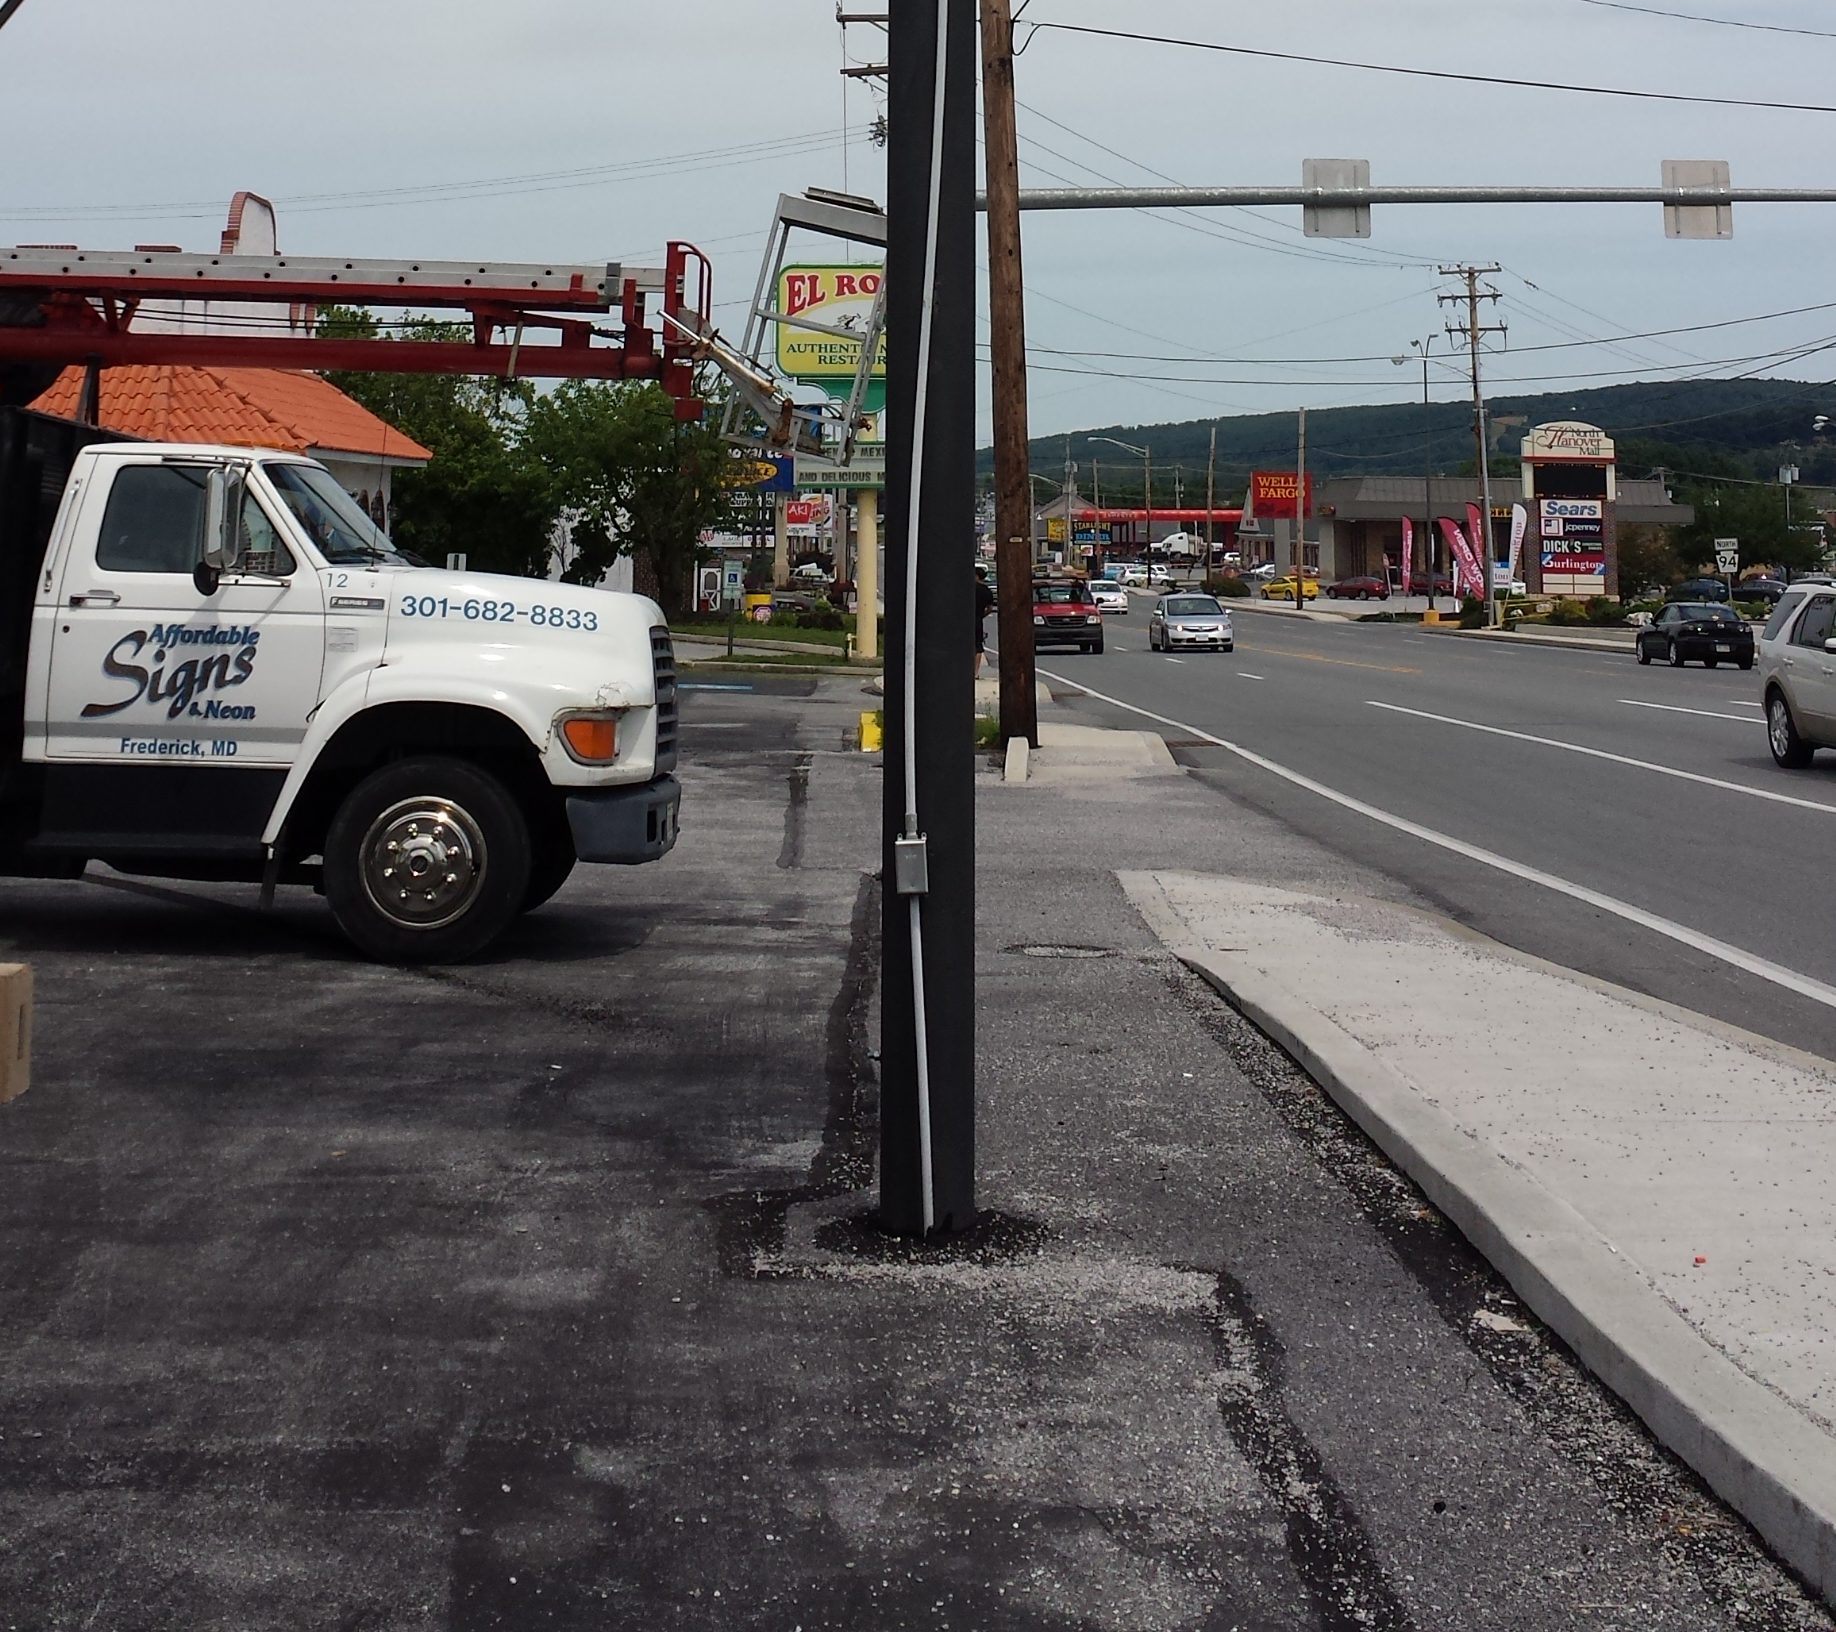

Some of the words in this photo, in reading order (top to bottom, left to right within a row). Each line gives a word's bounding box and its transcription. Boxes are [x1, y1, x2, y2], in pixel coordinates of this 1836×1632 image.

[786, 274, 826, 316] EL
[835, 274, 881, 297] RO
[786, 343, 864, 354] AUTHENT
[817, 354, 887, 365] RESTR
[1537, 425, 1602, 449] Hanover
[1570, 427, 1600, 438] North
[860, 447, 885, 457] MEXI
[1579, 446, 1600, 456] Mall
[798, 471, 817, 482] AND
[821, 471, 871, 482] DELICIOUS
[1545, 501, 1597, 516] Sears
[1073, 522, 1111, 531] STARLIHT
[1564, 522, 1601, 533] jcpenney
[1542, 539, 1582, 553] DICK'S
[1716, 540, 1736, 548] NORTH
[1718, 555, 1737, 568] 94
[325, 572, 349, 588] 12
[400, 595, 599, 632] 301-682-8833
[147, 624, 260, 648] Affordable
[80, 630, 257, 719] Signs
[189, 702, 203, 716] &
[202, 700, 256, 720] Neon
[120, 738, 205, 757] Frederick,
[211, 740, 237, 756] MD
